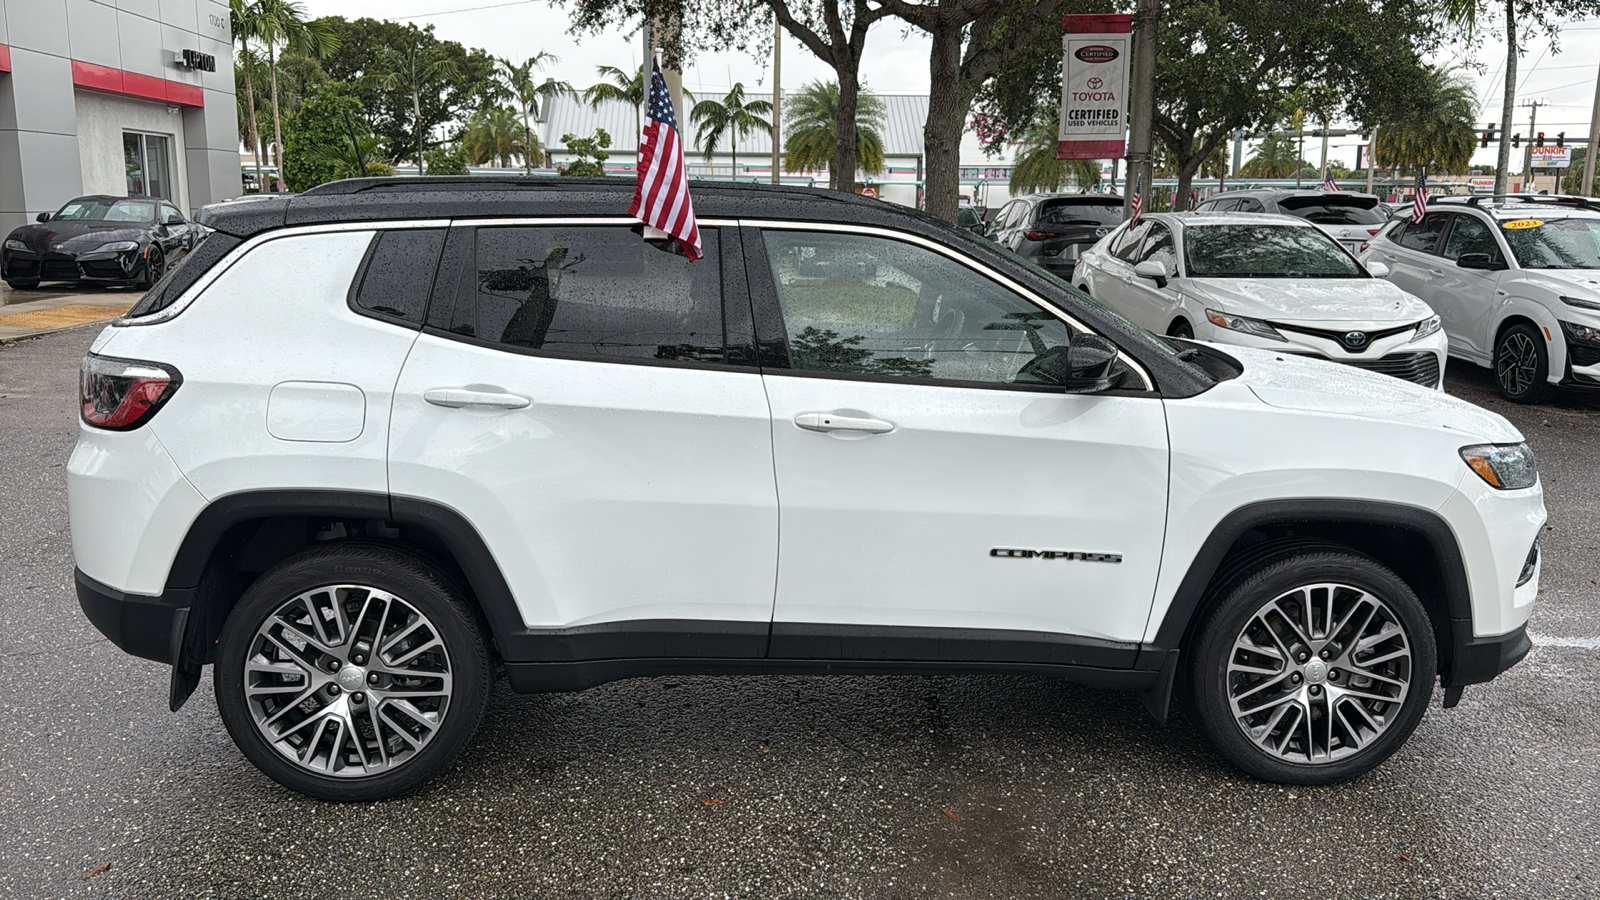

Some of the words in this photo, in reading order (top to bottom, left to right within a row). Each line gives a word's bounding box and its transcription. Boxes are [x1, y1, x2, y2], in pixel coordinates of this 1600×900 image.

[187, 50, 216, 72] LIPTON
[1072, 92, 1115, 102] TOYOTA
[1069, 110, 1119, 120] CERTIFIED
[990, 548, 1122, 563] COMPASS
